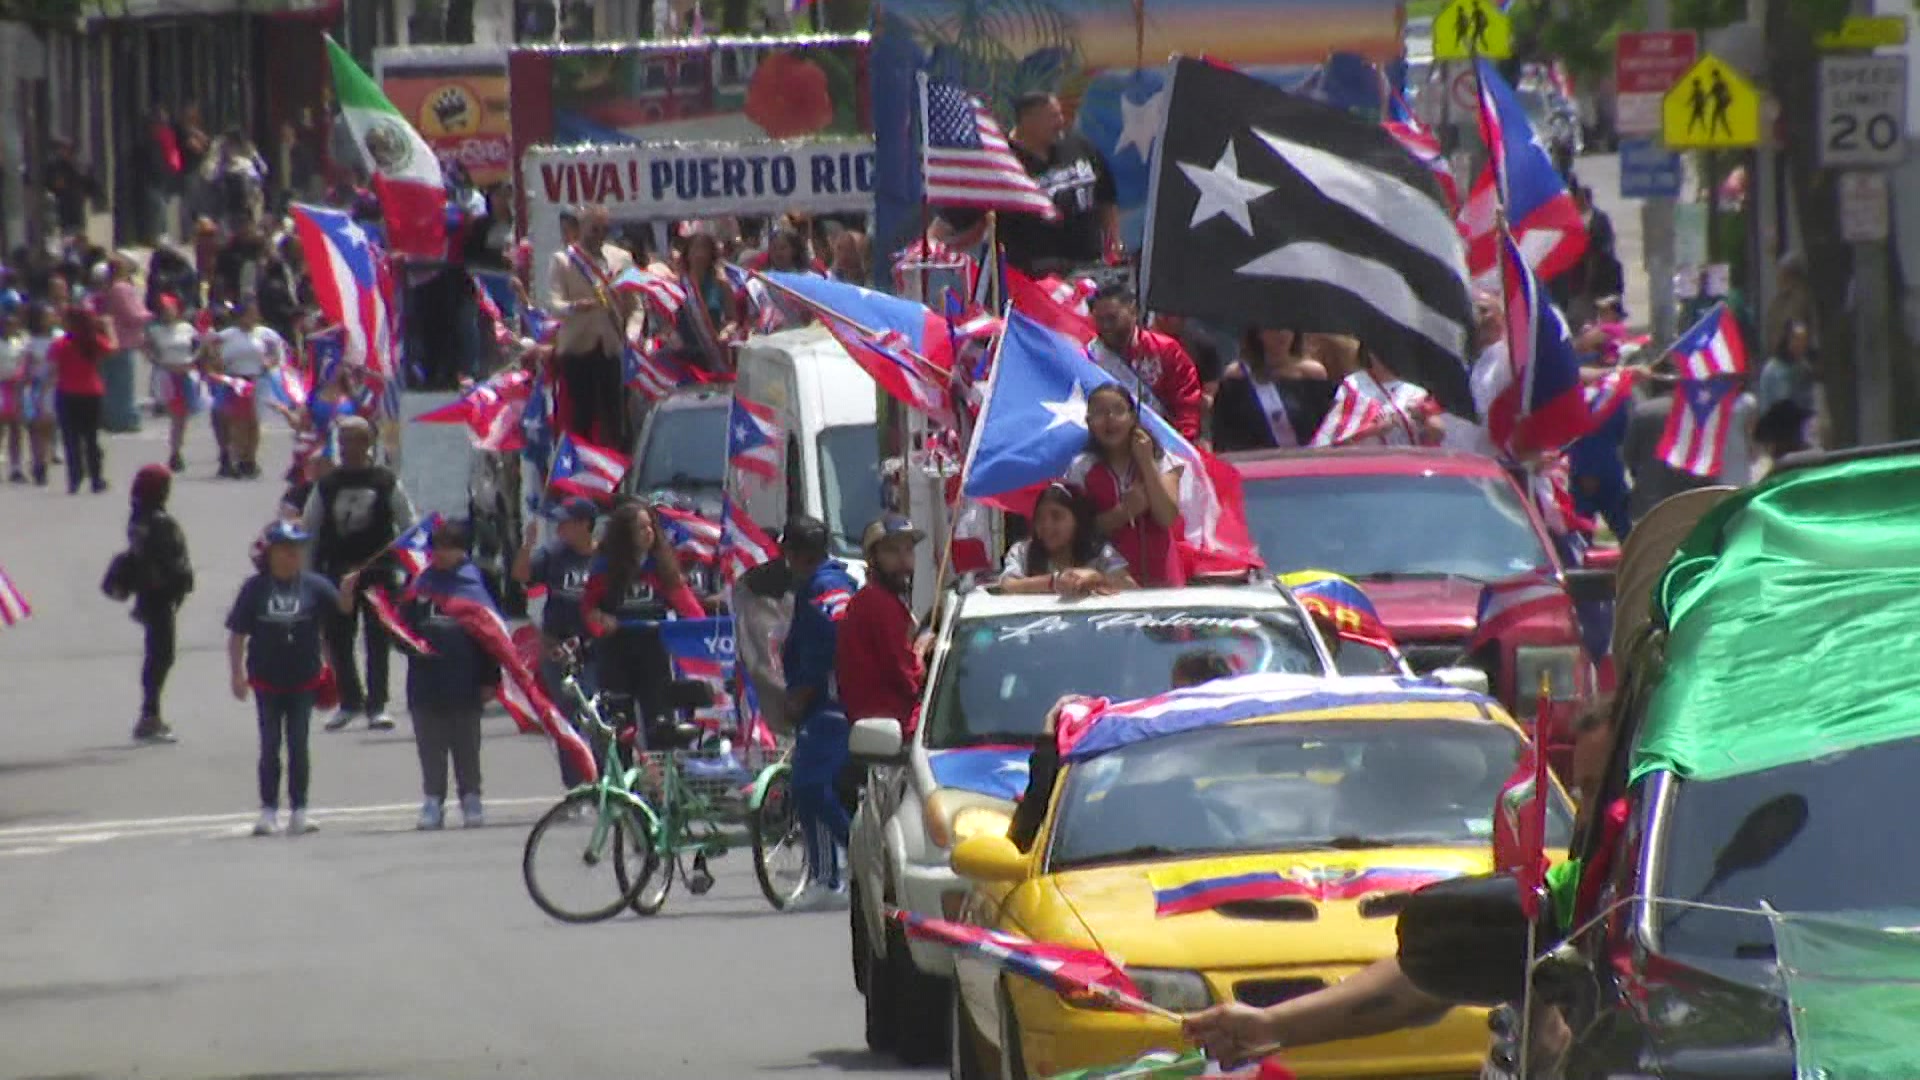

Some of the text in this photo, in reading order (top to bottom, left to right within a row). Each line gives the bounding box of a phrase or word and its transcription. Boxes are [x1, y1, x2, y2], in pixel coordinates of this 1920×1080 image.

[1828, 113, 1899, 151] 20
[541, 159, 639, 204] VIVA!
[650, 155, 797, 200] PUERTO
